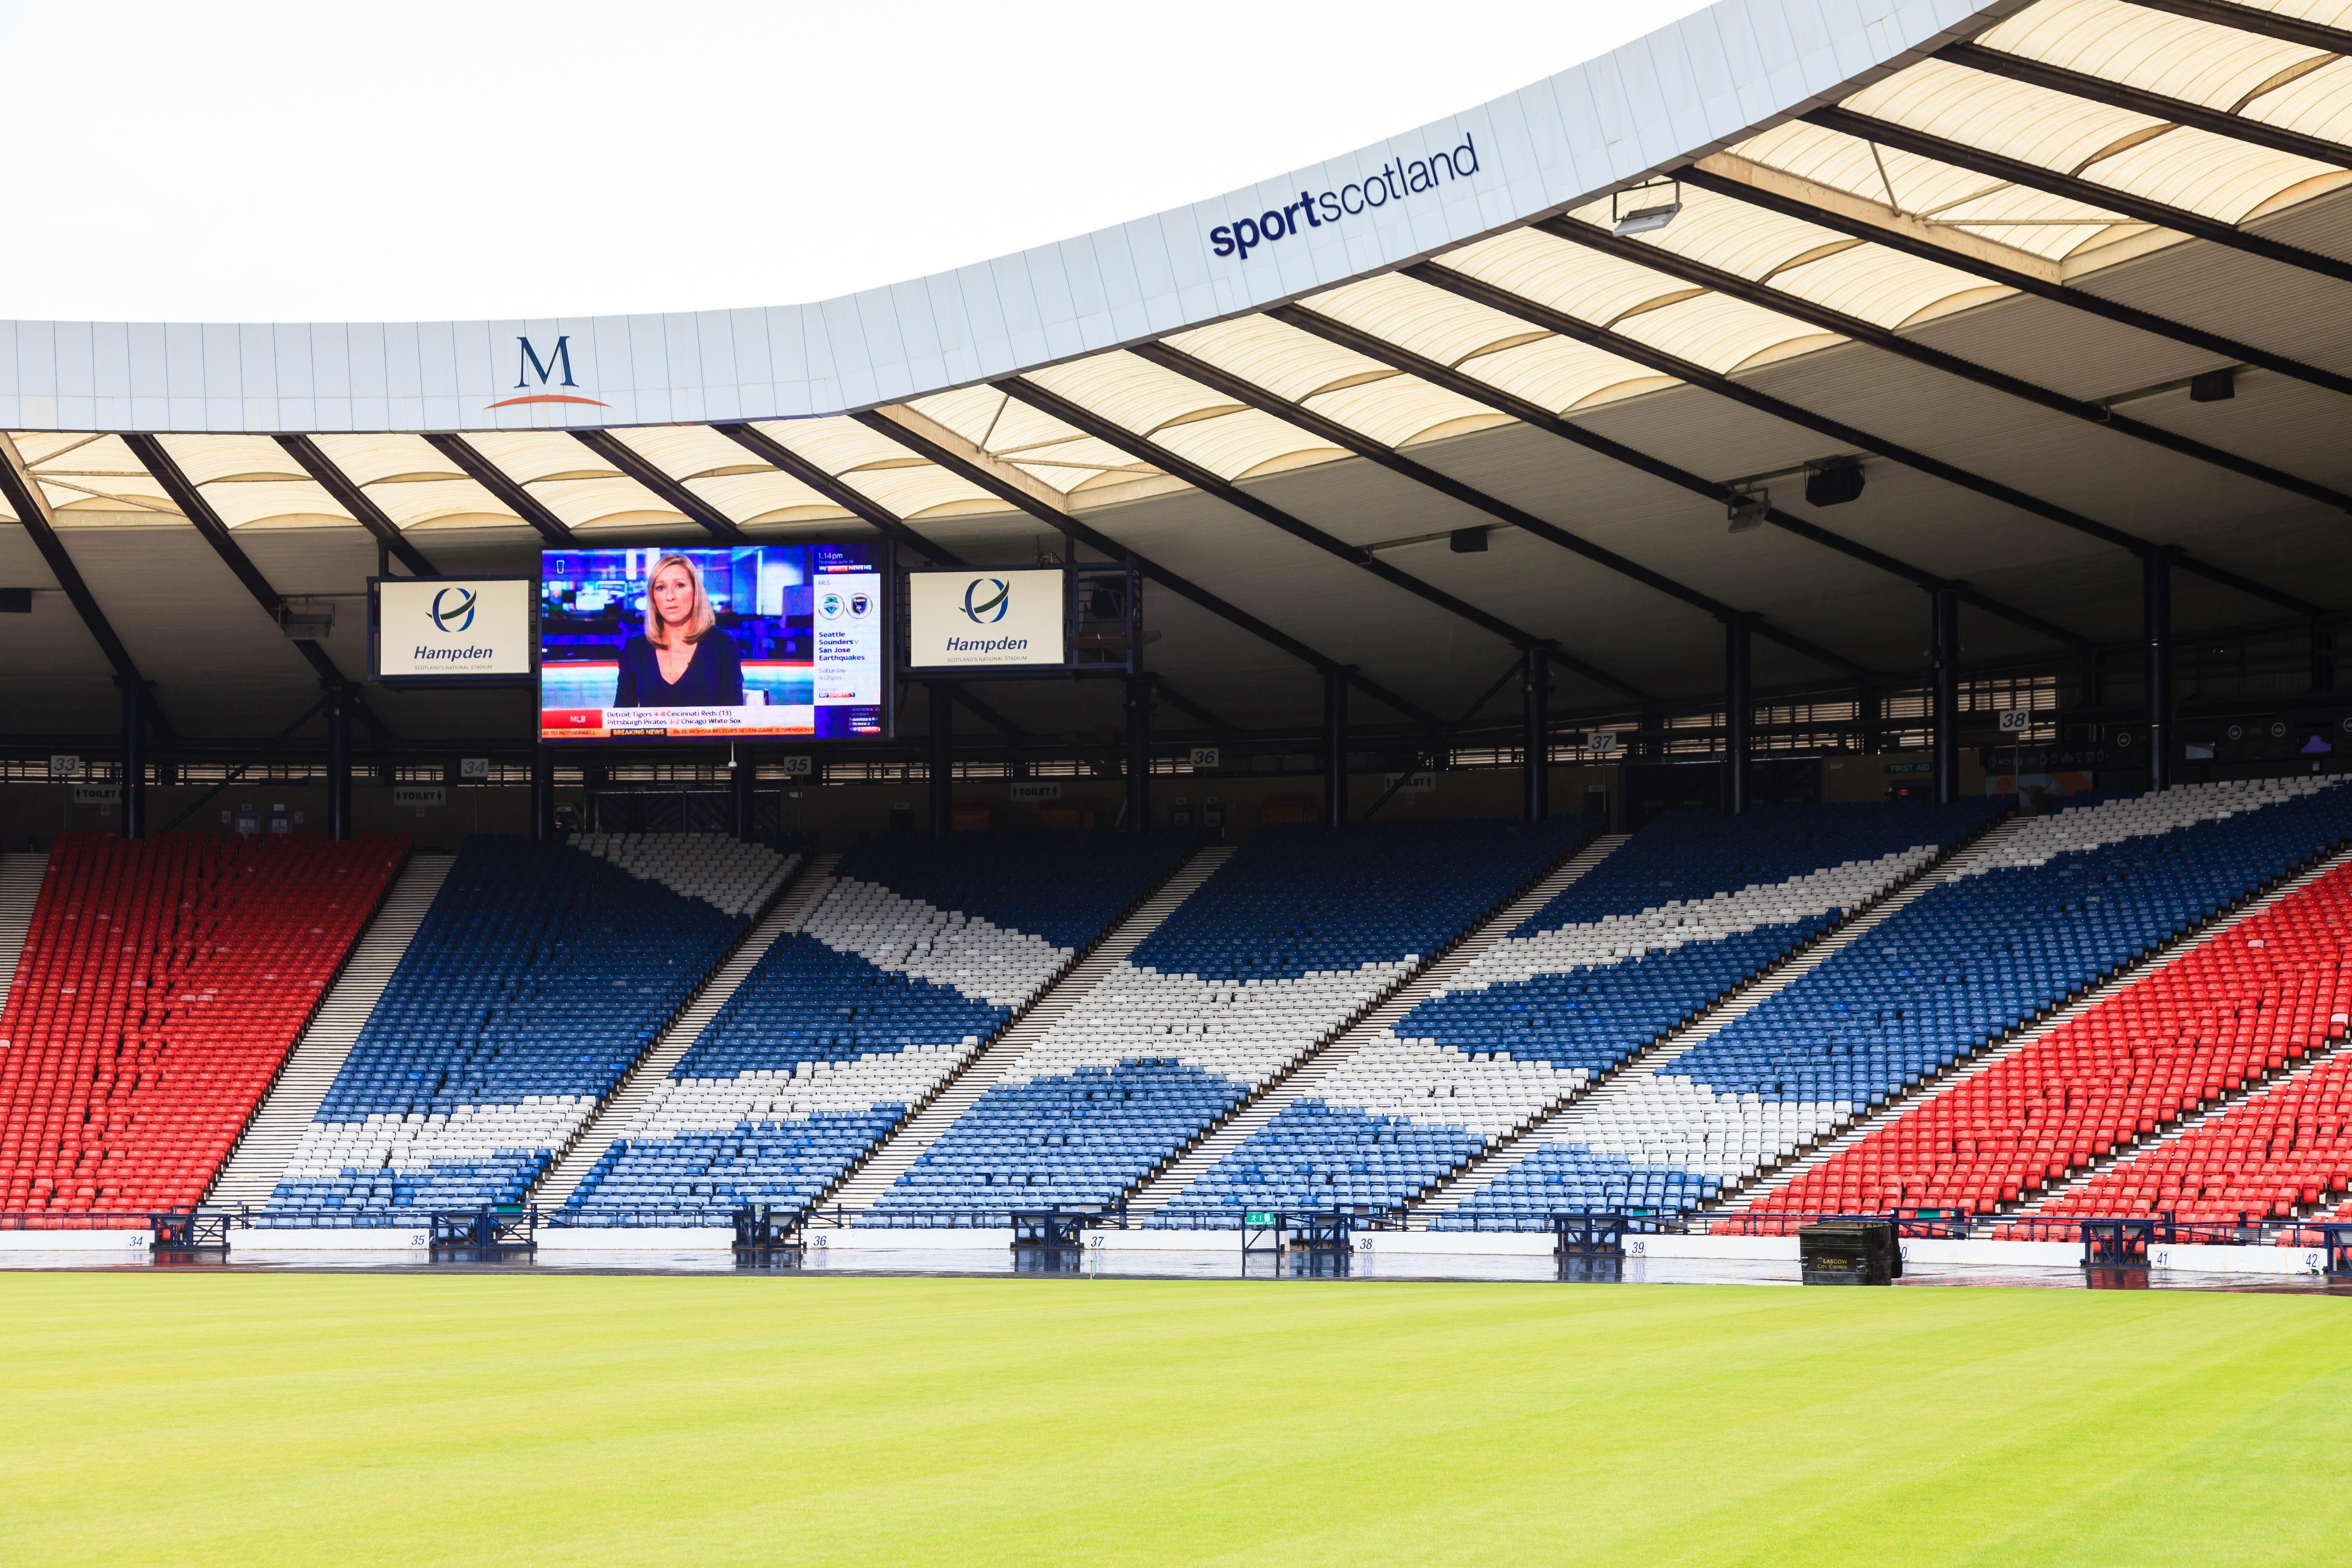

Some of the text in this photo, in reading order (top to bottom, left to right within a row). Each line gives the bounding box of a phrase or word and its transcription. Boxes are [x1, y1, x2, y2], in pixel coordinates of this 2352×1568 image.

[1210, 132, 1479, 260] sportscotland
[514, 335, 579, 388] M
[946, 636, 1028, 653] Hampden
[414, 645, 493, 662] Hampden
[2003, 712, 2026, 728] 38
[1591, 735, 1613, 749] 37
[1194, 751, 1216, 764] 36
[54, 758, 76, 771] 33
[465, 761, 485, 774] 34
[787, 759, 808, 772] 35
[83, 790, 116, 798] TOILET
[1019, 788, 1051, 796] TOILET
[129, 1236, 143, 1247] 34
[411, 1235, 425, 1245] 35
[814, 1236, 827, 1246] 36
[1090, 1236, 1104, 1247] 37
[1360, 1239, 1372, 1250] 38
[1632, 1242, 1644, 1253] 39
[1900, 1246, 1907, 1259] 0
[2157, 1252, 2168, 1266] 41
[2306, 1253, 2318, 1267] 42
